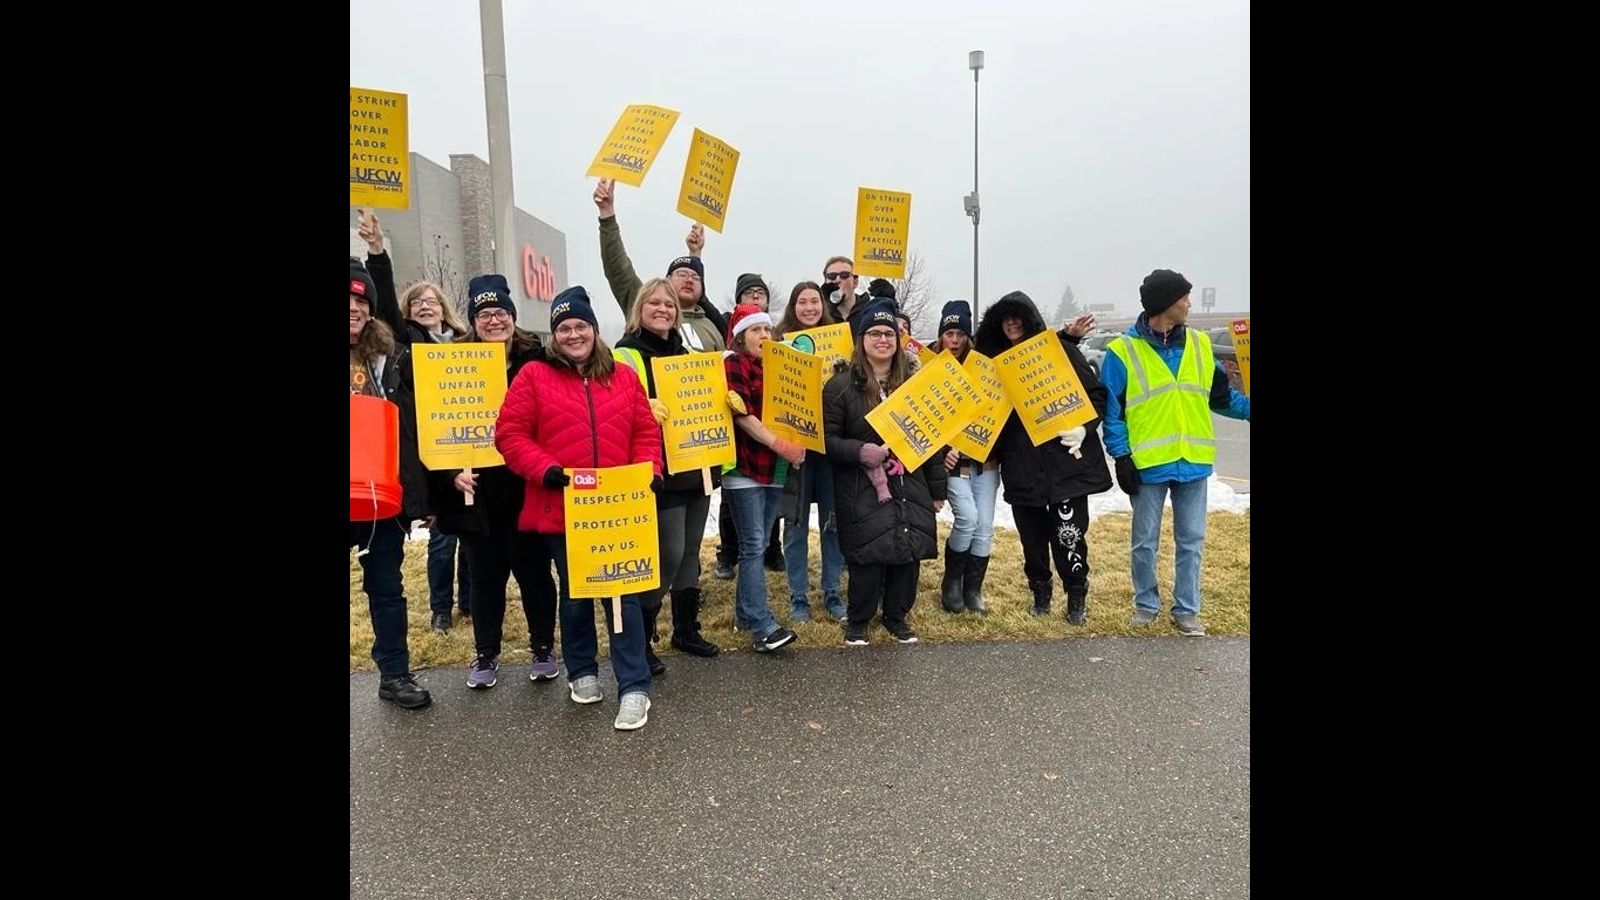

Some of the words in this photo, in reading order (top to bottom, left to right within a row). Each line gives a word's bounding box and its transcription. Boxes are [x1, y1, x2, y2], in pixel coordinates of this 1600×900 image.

[358, 96, 397, 107] STRIKE
[352, 110, 382, 120] OVER
[635, 117, 654, 125] OVER
[643, 109, 670, 120] STRIKE
[625, 125, 654, 135] UNFAIR
[622, 135, 647, 143] LABOR
[609, 142, 650, 155] PRACTICES
[700, 137, 710, 146] ON
[714, 143, 734, 159] STRIKE
[351, 153, 399, 164] ACTICES
[614, 153, 647, 165] UFCW
[707, 151, 724, 163] OVER
[356, 167, 401, 182] UFCW
[701, 160, 724, 176] UNFAIR
[700, 171, 721, 184] LABOR
[690, 176, 724, 199] PRACTICES
[699, 191, 723, 213] UFCW
[880, 195, 904, 204] STRIKE
[875, 205, 894, 213] OVER
[862, 236, 902, 245] PRACTICES
[873, 248, 902, 259] UFCW
[522, 244, 556, 303] Cub
[812, 330, 841, 339] STRIKE
[427, 351, 445, 359] ON
[451, 351, 494, 359] STRIKE
[772, 348, 784, 356] ON
[788, 353, 813, 368] STRIKE
[1003, 354, 1016, 365] ON
[1019, 338, 1048, 356] STRIKE
[665, 364, 679, 372] ON
[683, 359, 715, 369] STRIKE
[975, 359, 989, 369] ON
[1020, 354, 1042, 370] OVER
[445, 366, 478, 374] OVER
[784, 364, 802, 376] OVER
[1019, 363, 1053, 383] UNFAIR
[439, 381, 486, 390] UNFAIR
[681, 375, 705, 384] OVER
[779, 374, 807, 390] UNFAIR
[945, 362, 957, 375] ON
[958, 376, 982, 405] STRIKE
[981, 375, 1002, 389] OVER
[1027, 375, 1057, 393] LABOR
[677, 387, 713, 398] UNFAIR
[781, 387, 806, 402] LABOR
[944, 381, 964, 404] OVER
[1024, 381, 1072, 408] PRACTICES
[443, 396, 485, 405] LABOR
[681, 401, 713, 412] LABOR
[773, 396, 814, 417] PRACTICES
[930, 384, 957, 416] UNFAIR
[1044, 391, 1080, 414] UFCW
[431, 410, 498, 420] PRACTICES
[921, 394, 945, 423] LABOR
[673, 414, 724, 427] PRACTICES
[786, 411, 817, 431] UFCW
[904, 395, 941, 439] PRACTICES
[691, 426, 728, 442] UFCW
[903, 415, 933, 449] UFCW
[574, 494, 626, 505] RESPECT
[631, 491, 649, 500] US.
[574, 518, 629, 530] PROTECT
[634, 515, 651, 524] US.
[591, 544, 615, 553] PAY
[620, 541, 639, 550] US.
[603, 558, 651, 578] UFCW
[623, 576, 640, 584] Local
